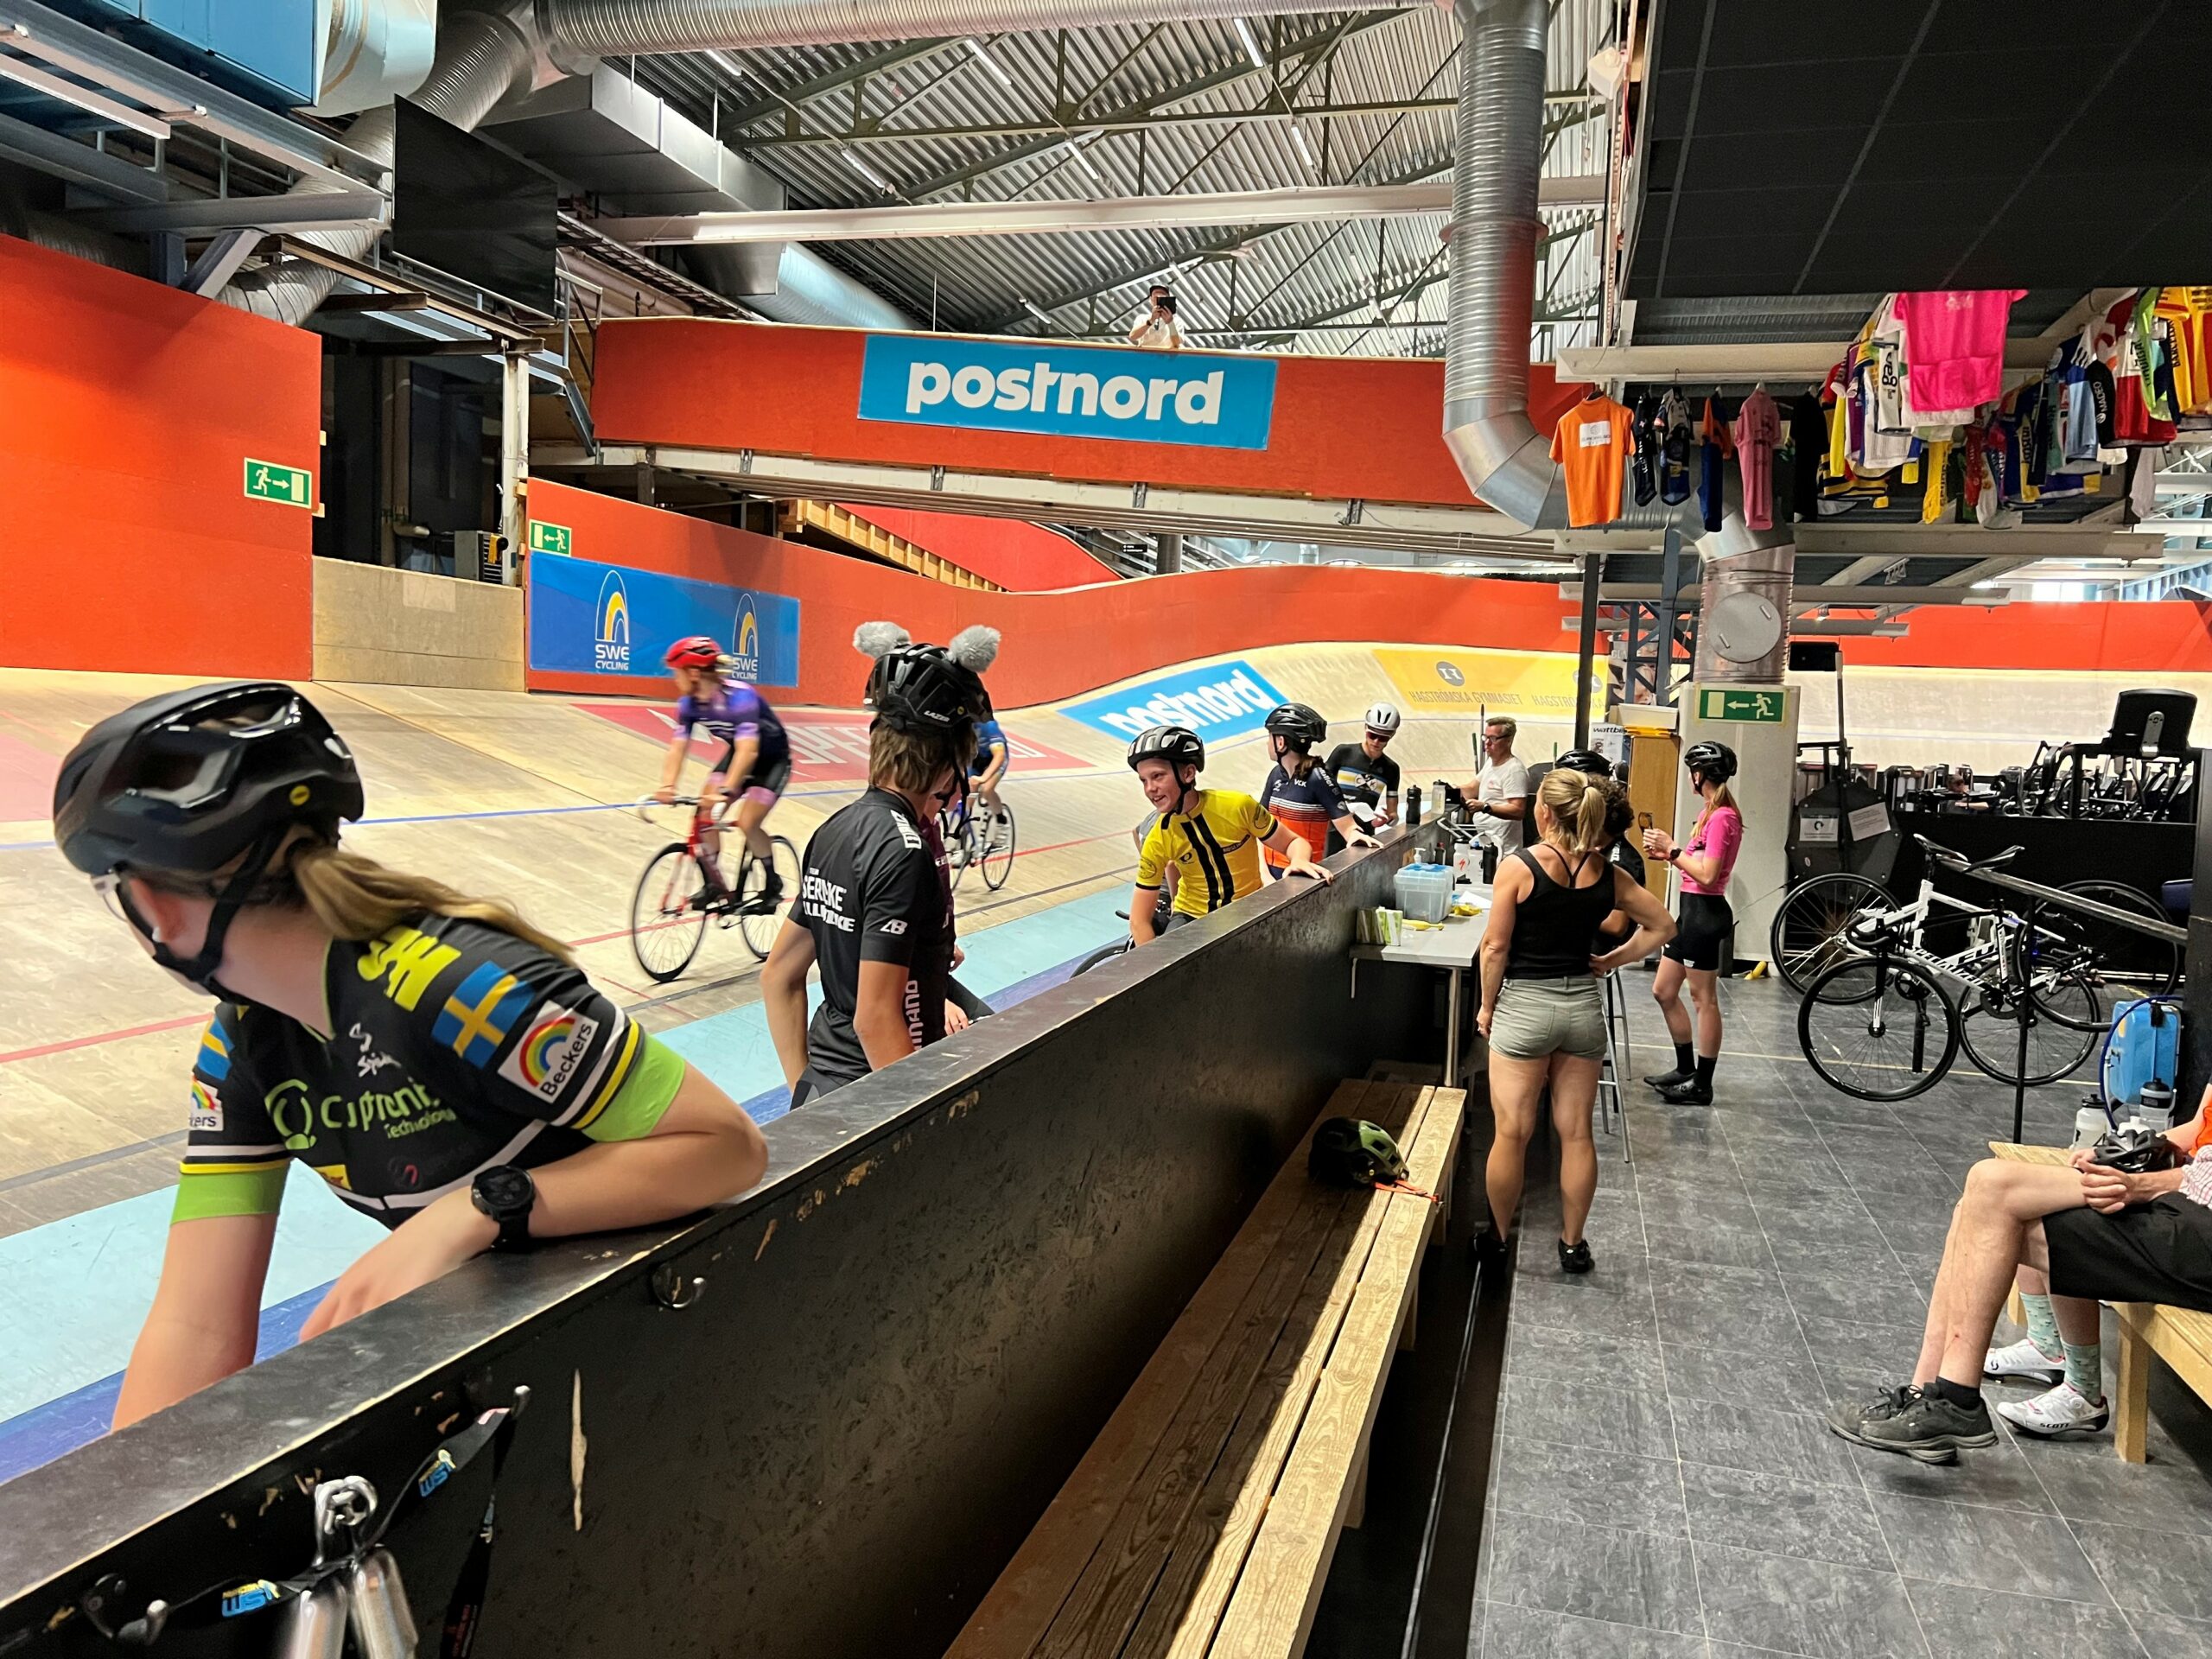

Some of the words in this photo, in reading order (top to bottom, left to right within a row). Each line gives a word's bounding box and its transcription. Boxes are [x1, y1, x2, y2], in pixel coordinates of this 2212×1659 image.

[906, 361, 1224, 425] postnord
[595, 644, 630, 661] SWE
[595, 660, 629, 671] CYCLING
[733, 657, 758, 671] SWE
[732, 671, 757, 681] CYCLING
[1531, 694, 1605, 709] HAGSTRÖKA
[540, 1024, 593, 1097] Beckers
